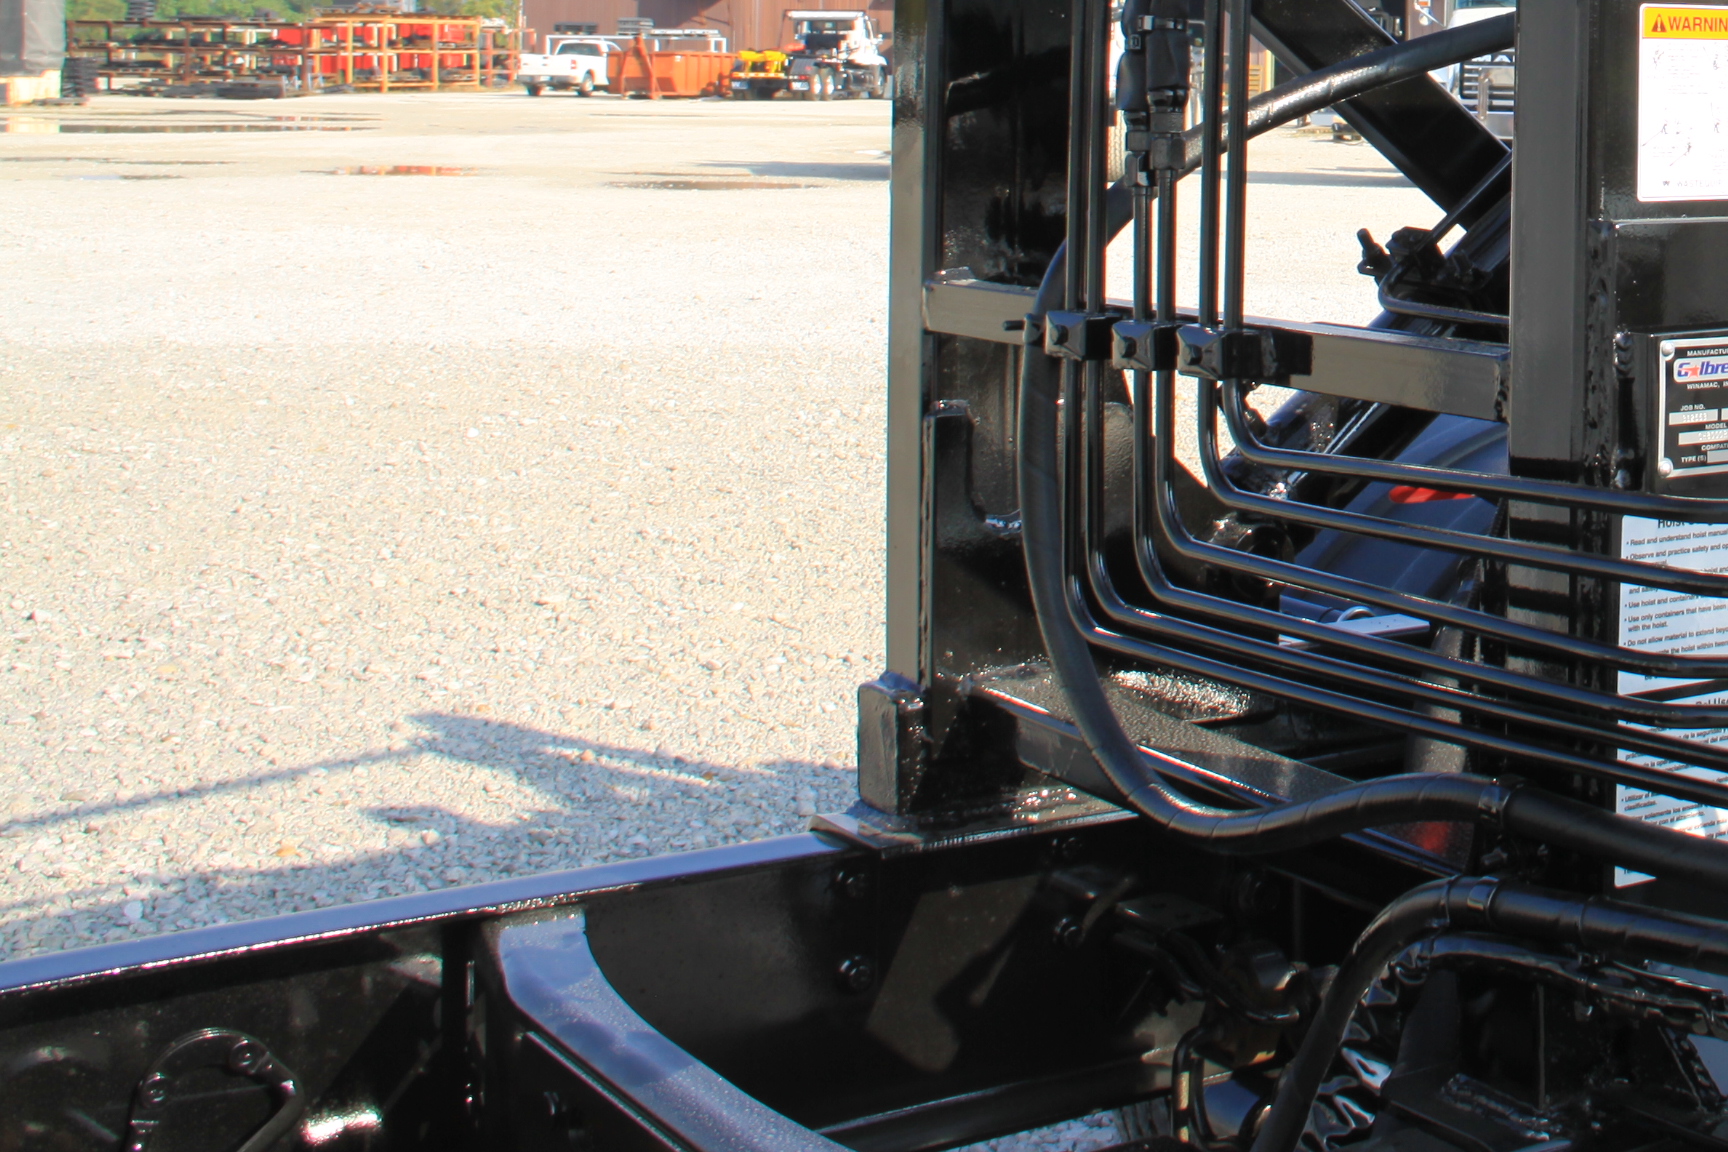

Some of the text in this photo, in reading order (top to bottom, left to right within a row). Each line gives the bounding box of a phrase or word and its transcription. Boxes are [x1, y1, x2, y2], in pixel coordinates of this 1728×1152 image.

[1630, 538, 1645, 546] Read
[1659, 533, 1691, 543] understand
[1708, 528, 1728, 537] manual
[1630, 552, 1654, 560] Observe
[1668, 547, 1691, 557] practice
[1692, 545, 1709, 553] safety
[1655, 609, 1684, 619] containers
[1664, 632, 1687, 640] material
[1696, 628, 1714, 636] extend
